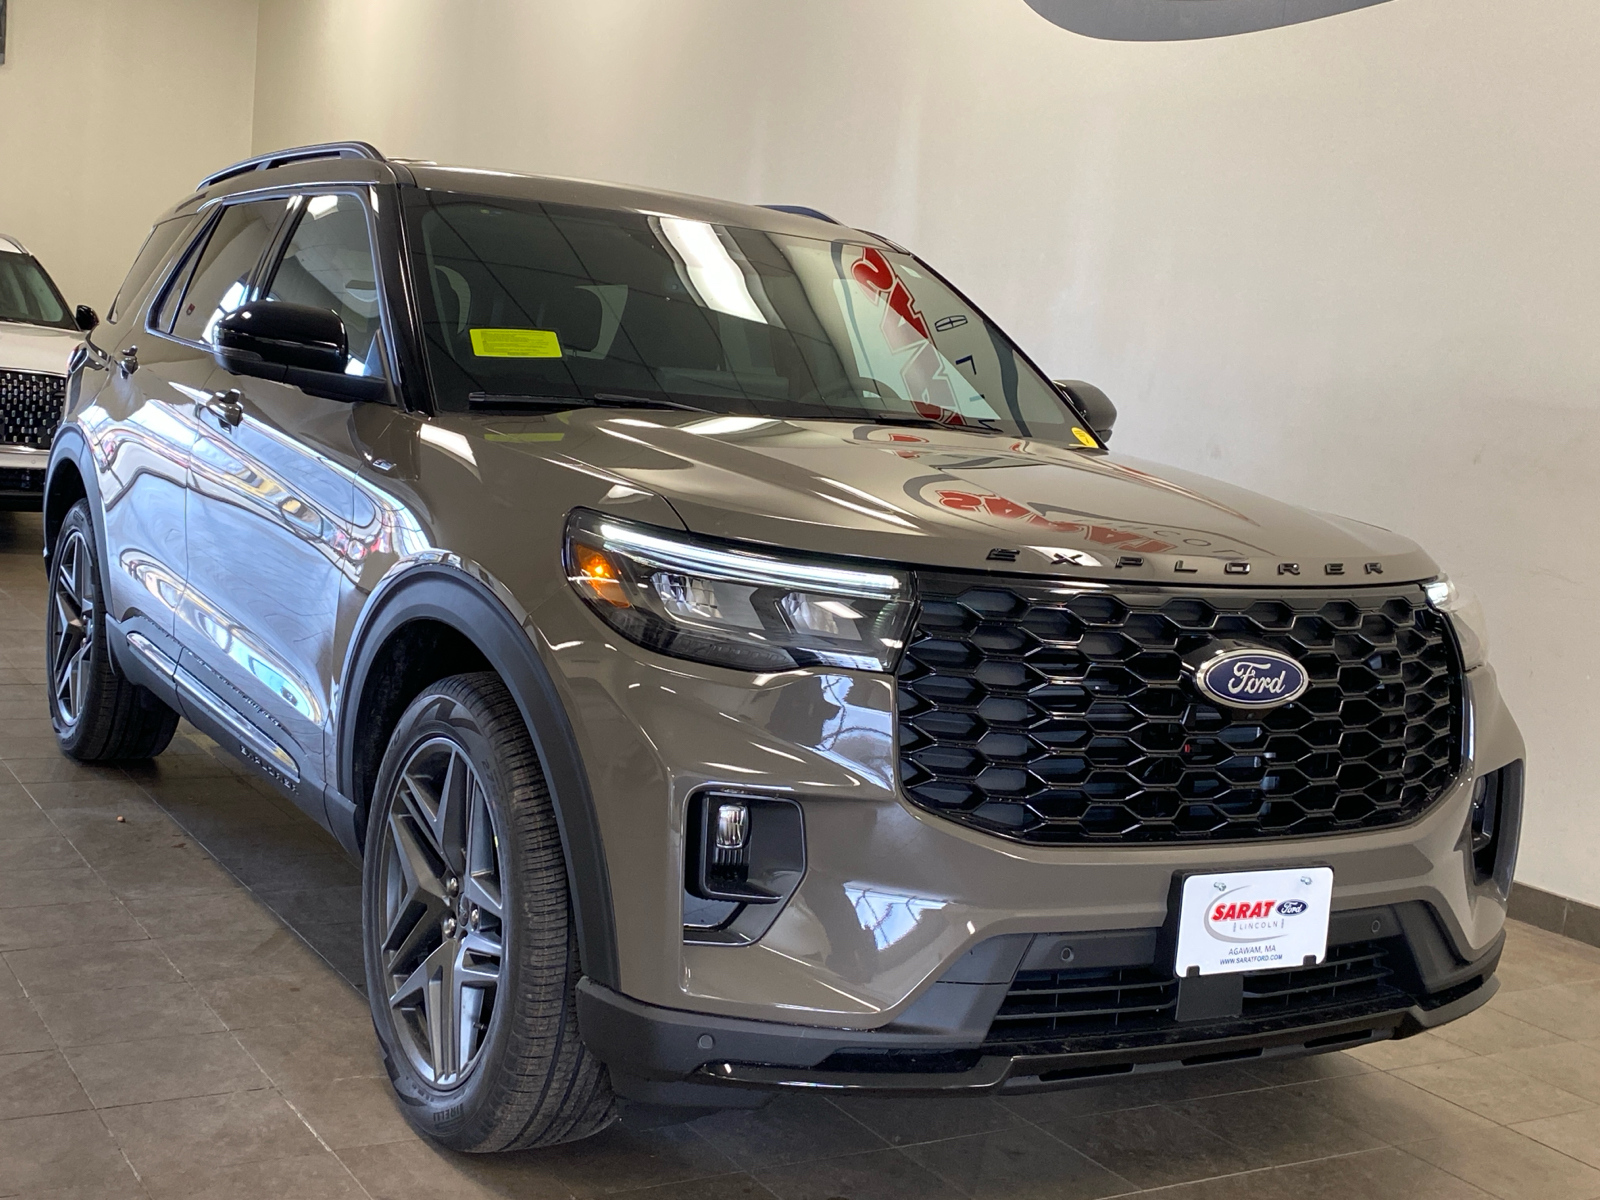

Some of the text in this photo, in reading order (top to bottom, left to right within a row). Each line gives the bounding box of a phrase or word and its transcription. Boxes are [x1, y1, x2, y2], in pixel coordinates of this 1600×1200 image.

[986, 547, 1383, 575] EXPLORER
[1227, 660, 1287, 695] Ford
[1212, 900, 1303, 922] SARAT Ford
[1239, 920, 1279, 931] LINCOLN
[1219, 953, 1283, 966] WWW.SARATFORD.COM
[1228, 944, 1276, 956] AGAWAM, MA
[432, 1103, 465, 1124] PIRELLI
